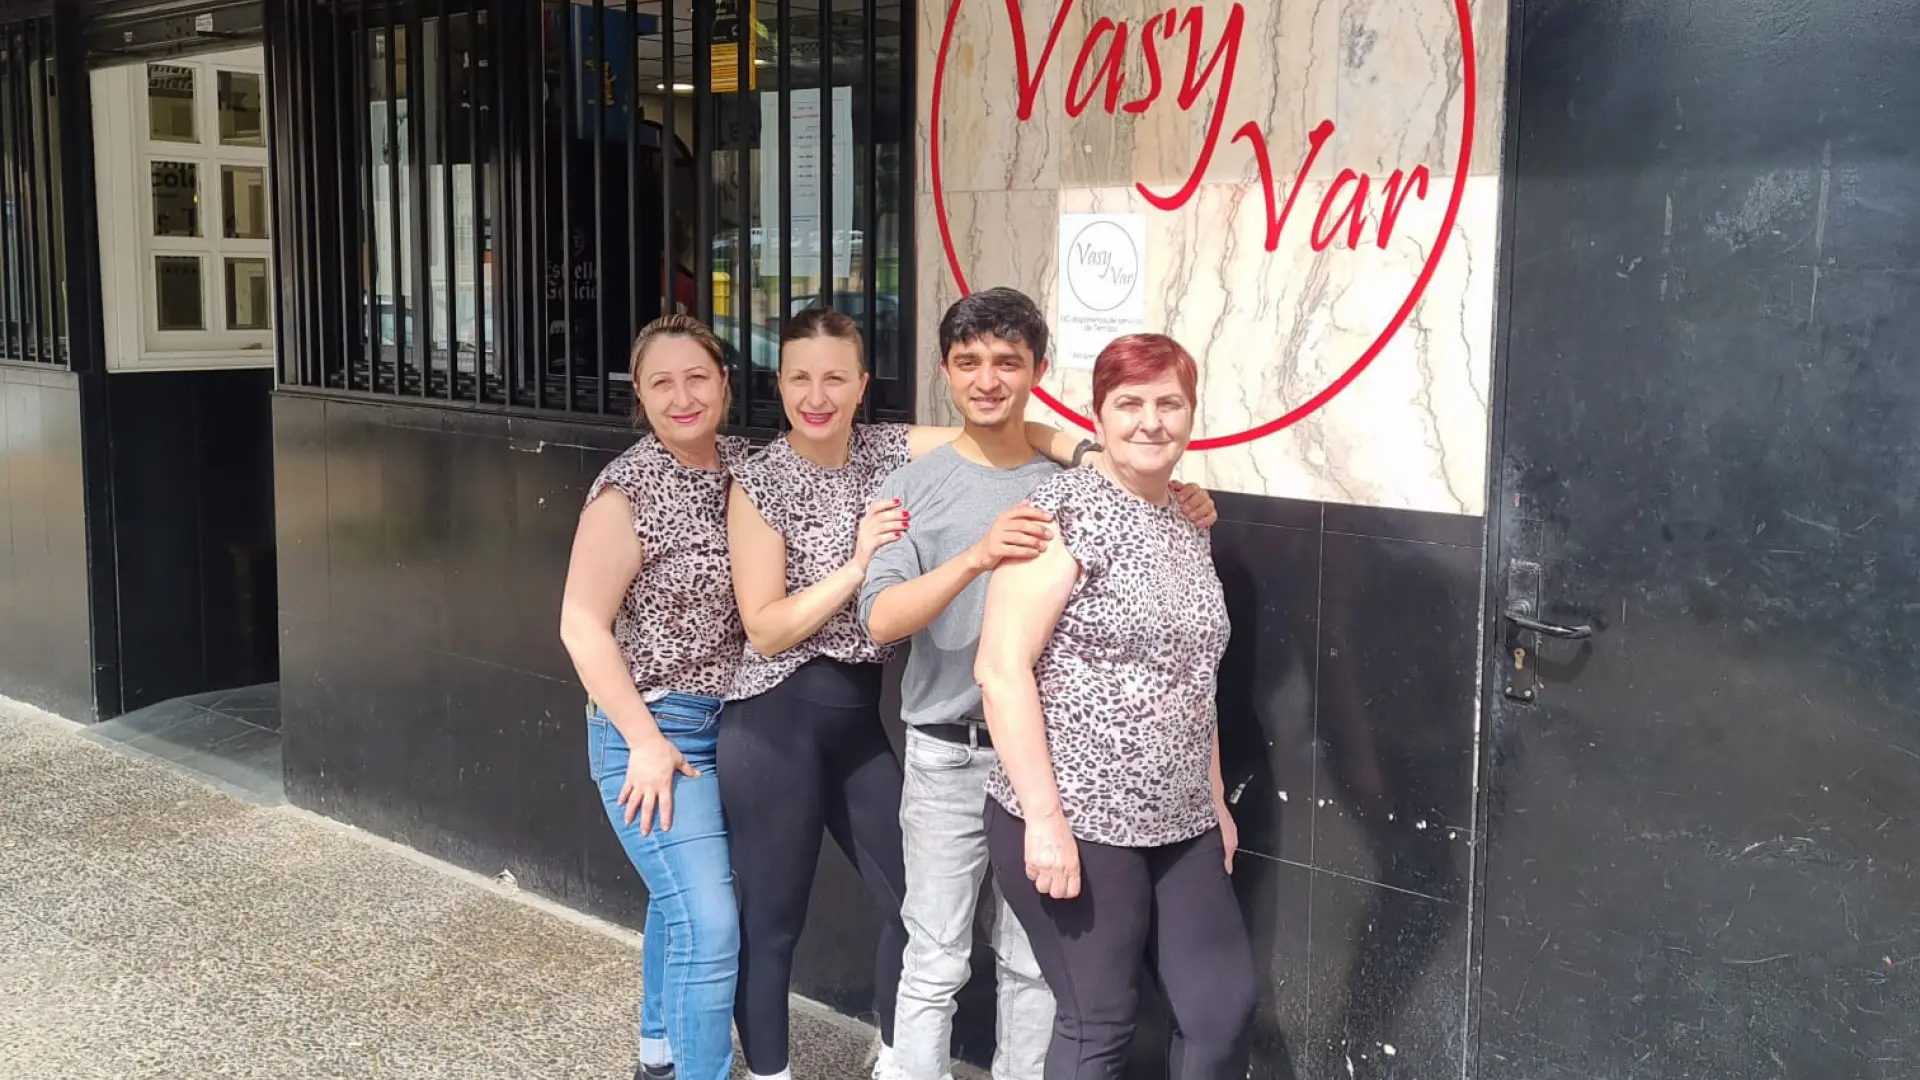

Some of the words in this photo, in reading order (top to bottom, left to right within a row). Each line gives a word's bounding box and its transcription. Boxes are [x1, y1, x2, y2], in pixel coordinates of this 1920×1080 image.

[1006, 0, 1243, 210] Vasy
[1232, 119, 1429, 252] Var
[1077, 242, 1112, 278] Vasy
[1111, 267, 1134, 285] Var
